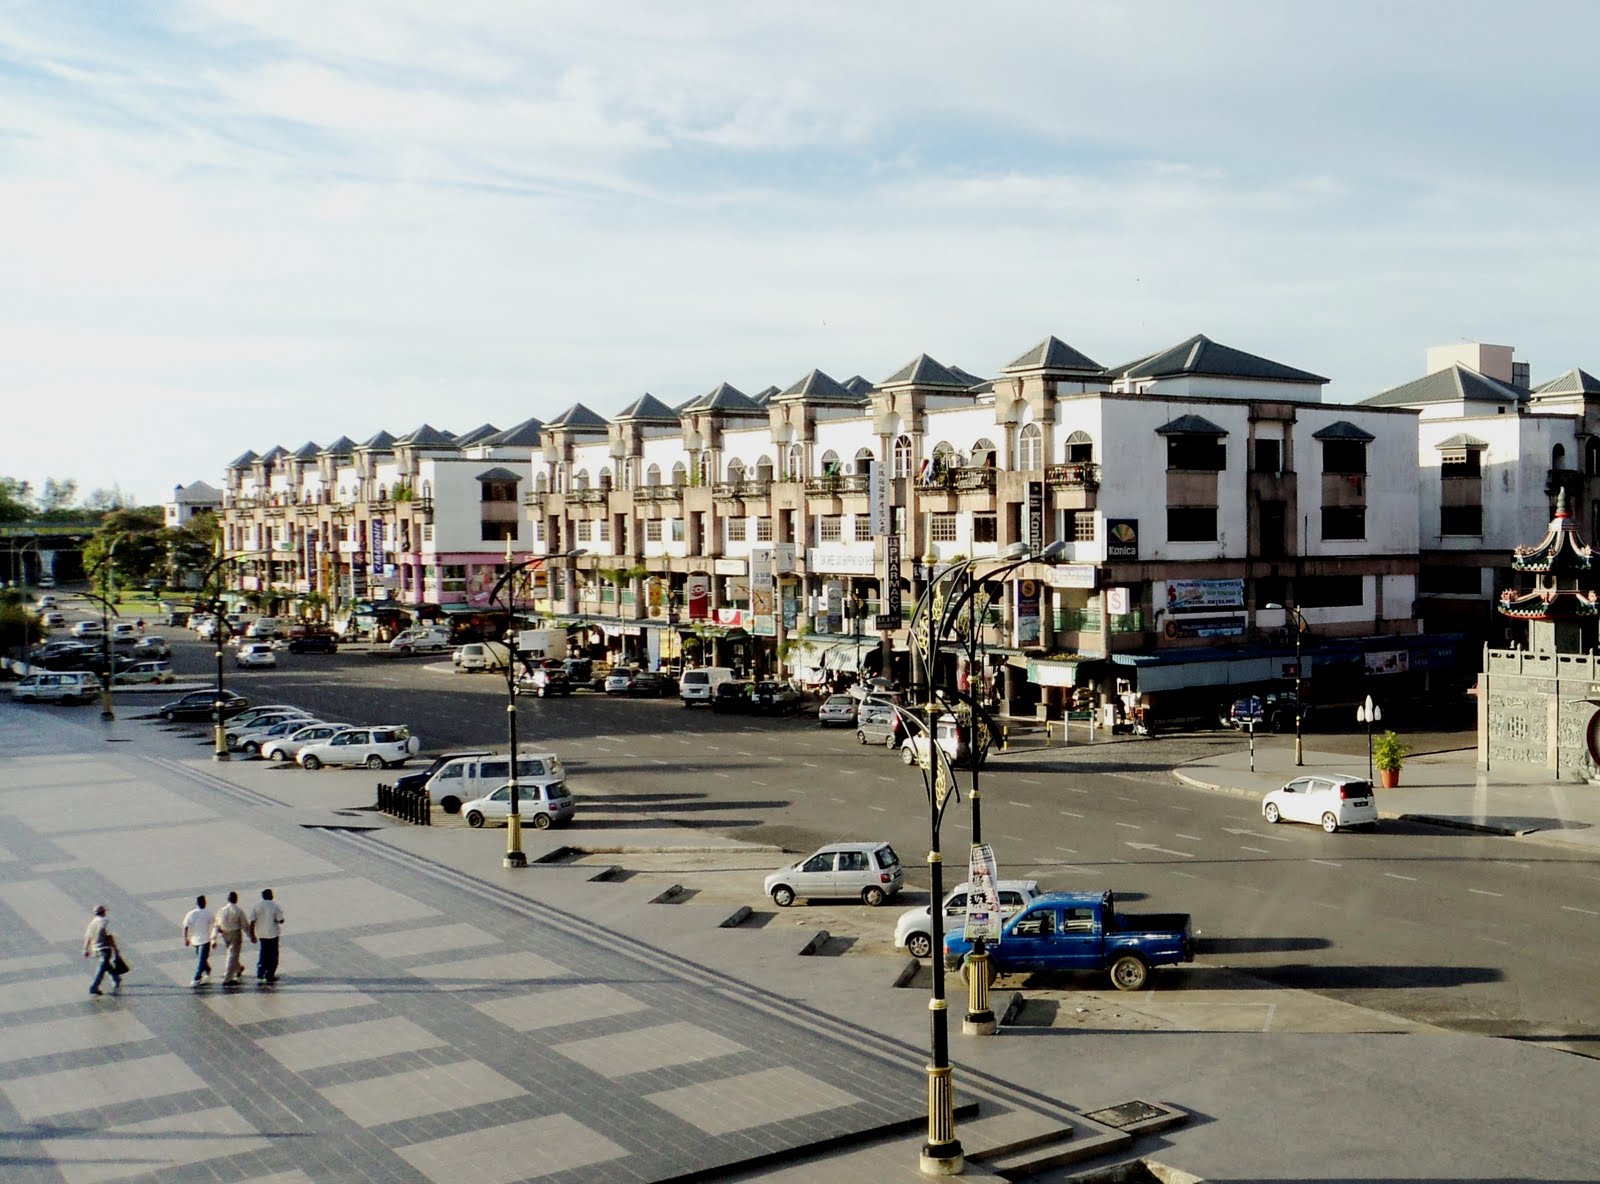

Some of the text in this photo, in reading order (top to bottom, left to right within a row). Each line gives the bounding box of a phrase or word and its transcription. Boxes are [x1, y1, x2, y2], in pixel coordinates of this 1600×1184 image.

[1031, 511, 1041, 559] Konica
[1109, 546, 1136, 555] Konica
[889, 548, 900, 612] PHARMACY
